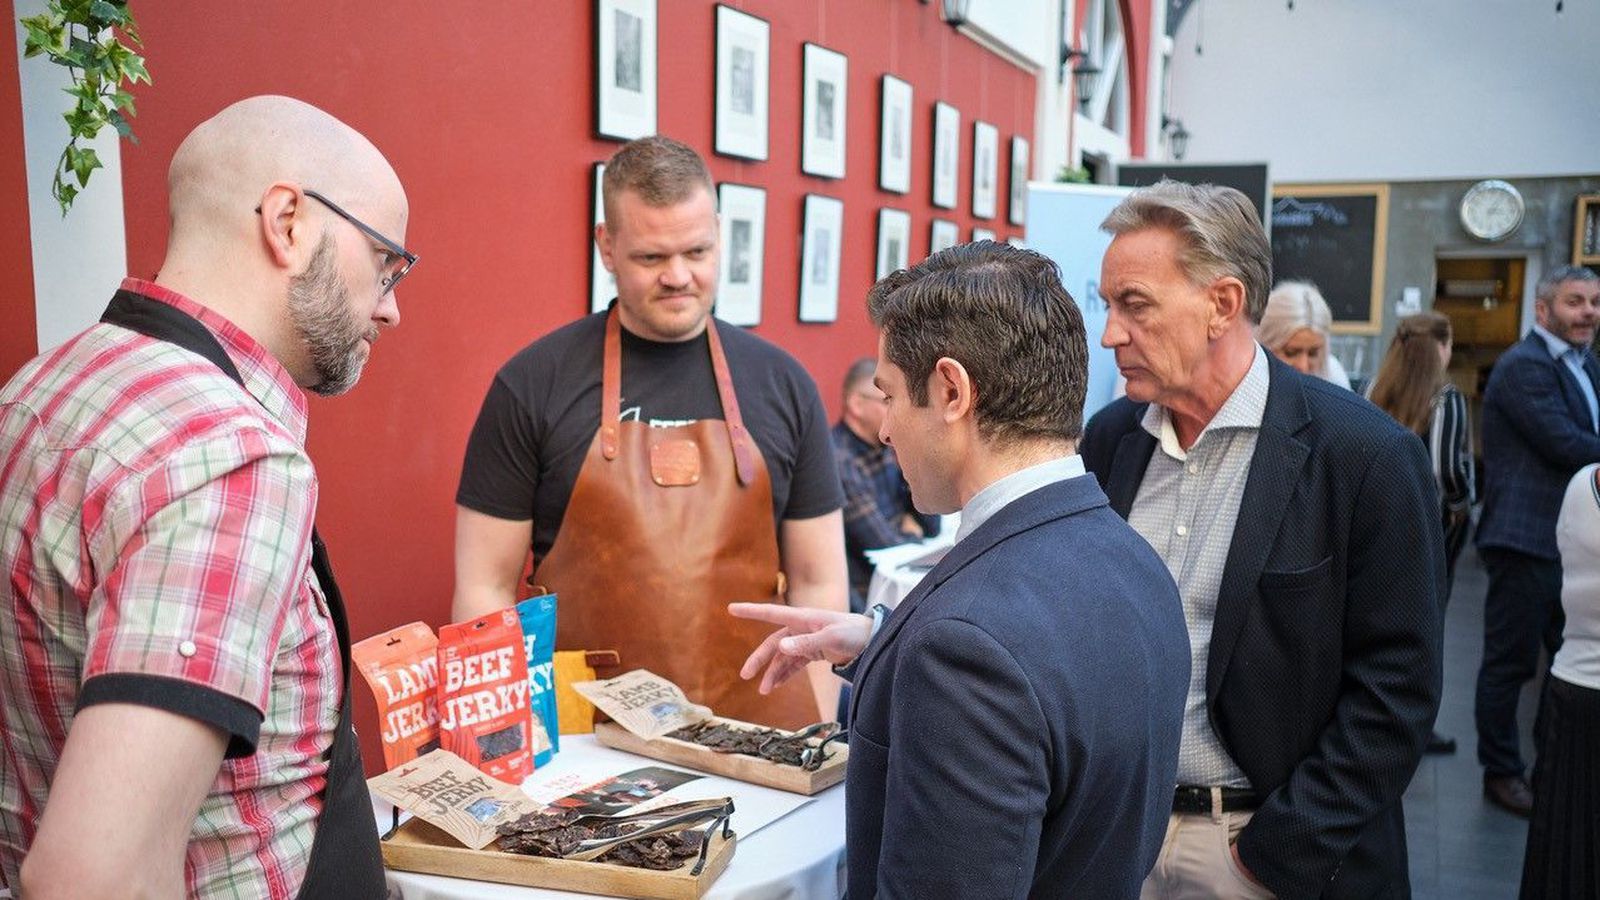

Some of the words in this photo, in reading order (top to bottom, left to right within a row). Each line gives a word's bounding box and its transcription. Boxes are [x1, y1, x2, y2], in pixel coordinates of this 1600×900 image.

[378, 656, 438, 705] LAM
[445, 646, 514, 693] BEEF
[383, 695, 440, 743] JERK
[441, 679, 528, 731] JERKY
[620, 687, 678, 711] JERKY
[408, 770, 462, 800] BEEF
[428, 776, 493, 815] JERKY
